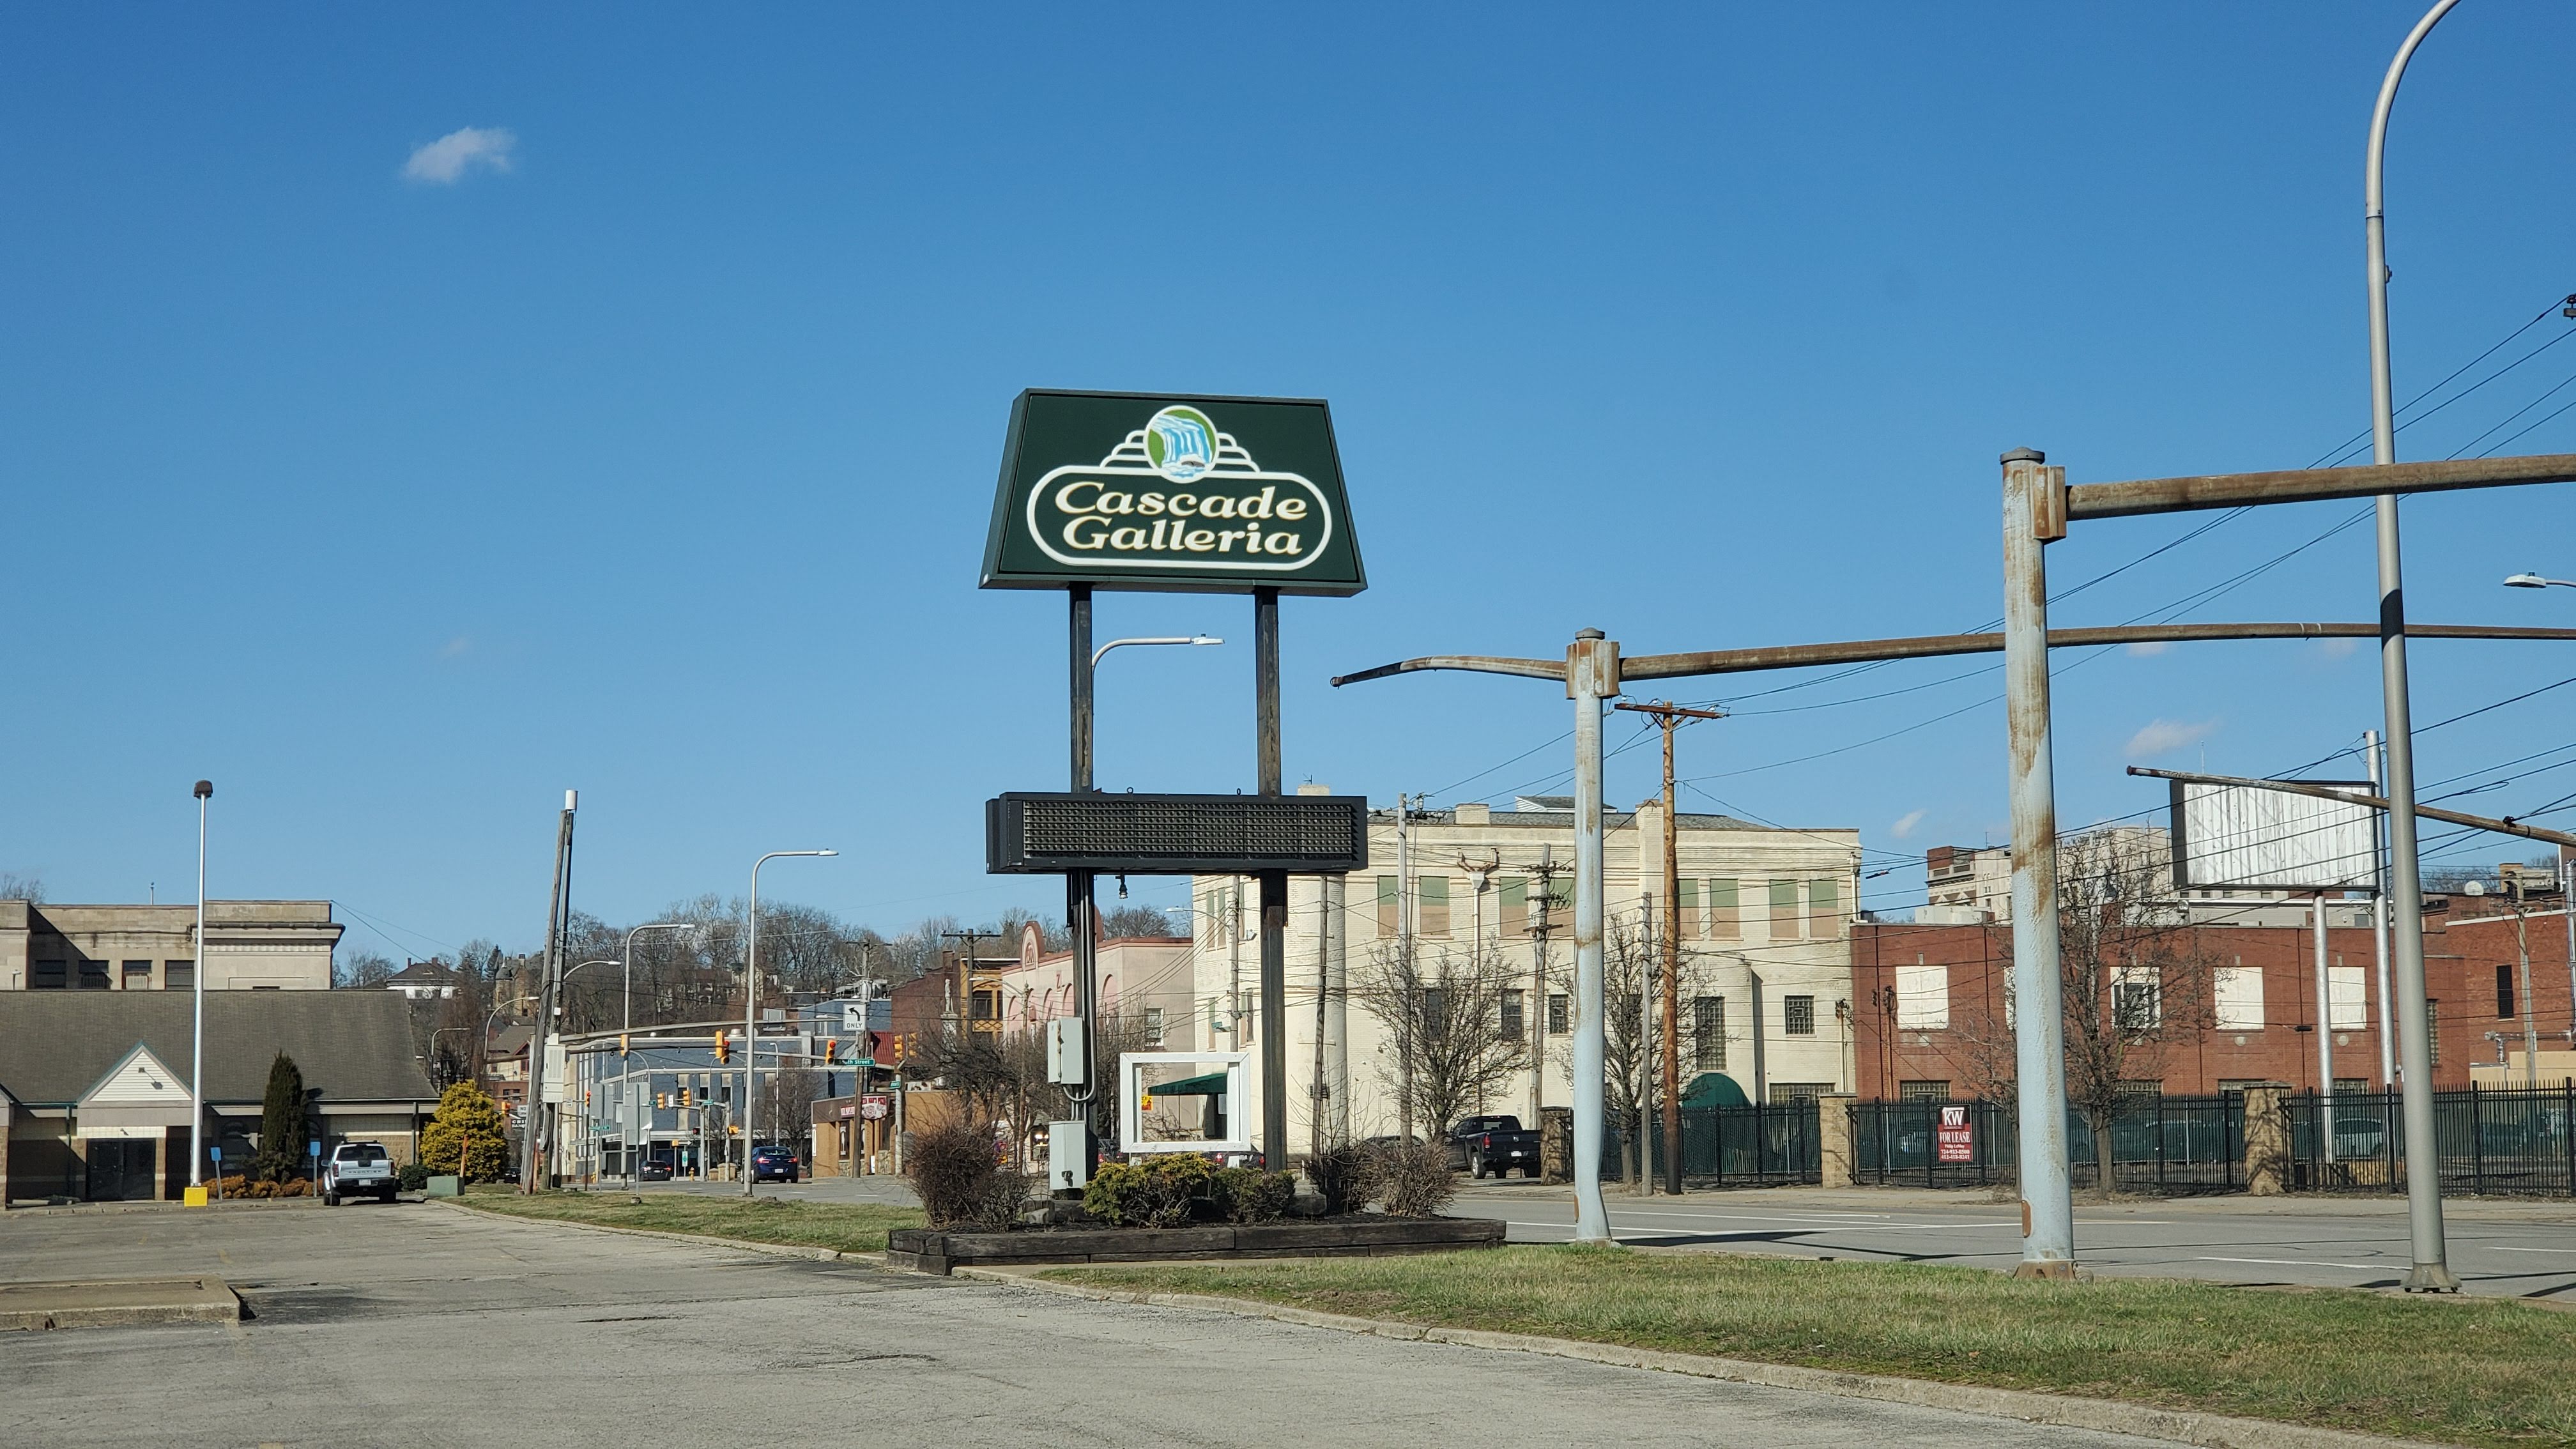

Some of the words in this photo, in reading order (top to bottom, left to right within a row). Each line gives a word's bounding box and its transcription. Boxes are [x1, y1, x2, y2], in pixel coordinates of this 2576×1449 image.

[1055, 480, 1308, 521] Cascade
[1062, 515, 1303, 555] Galleria
[1944, 1110, 1963, 1126] KW
[1940, 1131, 1952, 1143] FOR
[1952, 1131, 1970, 1143] LEASE
